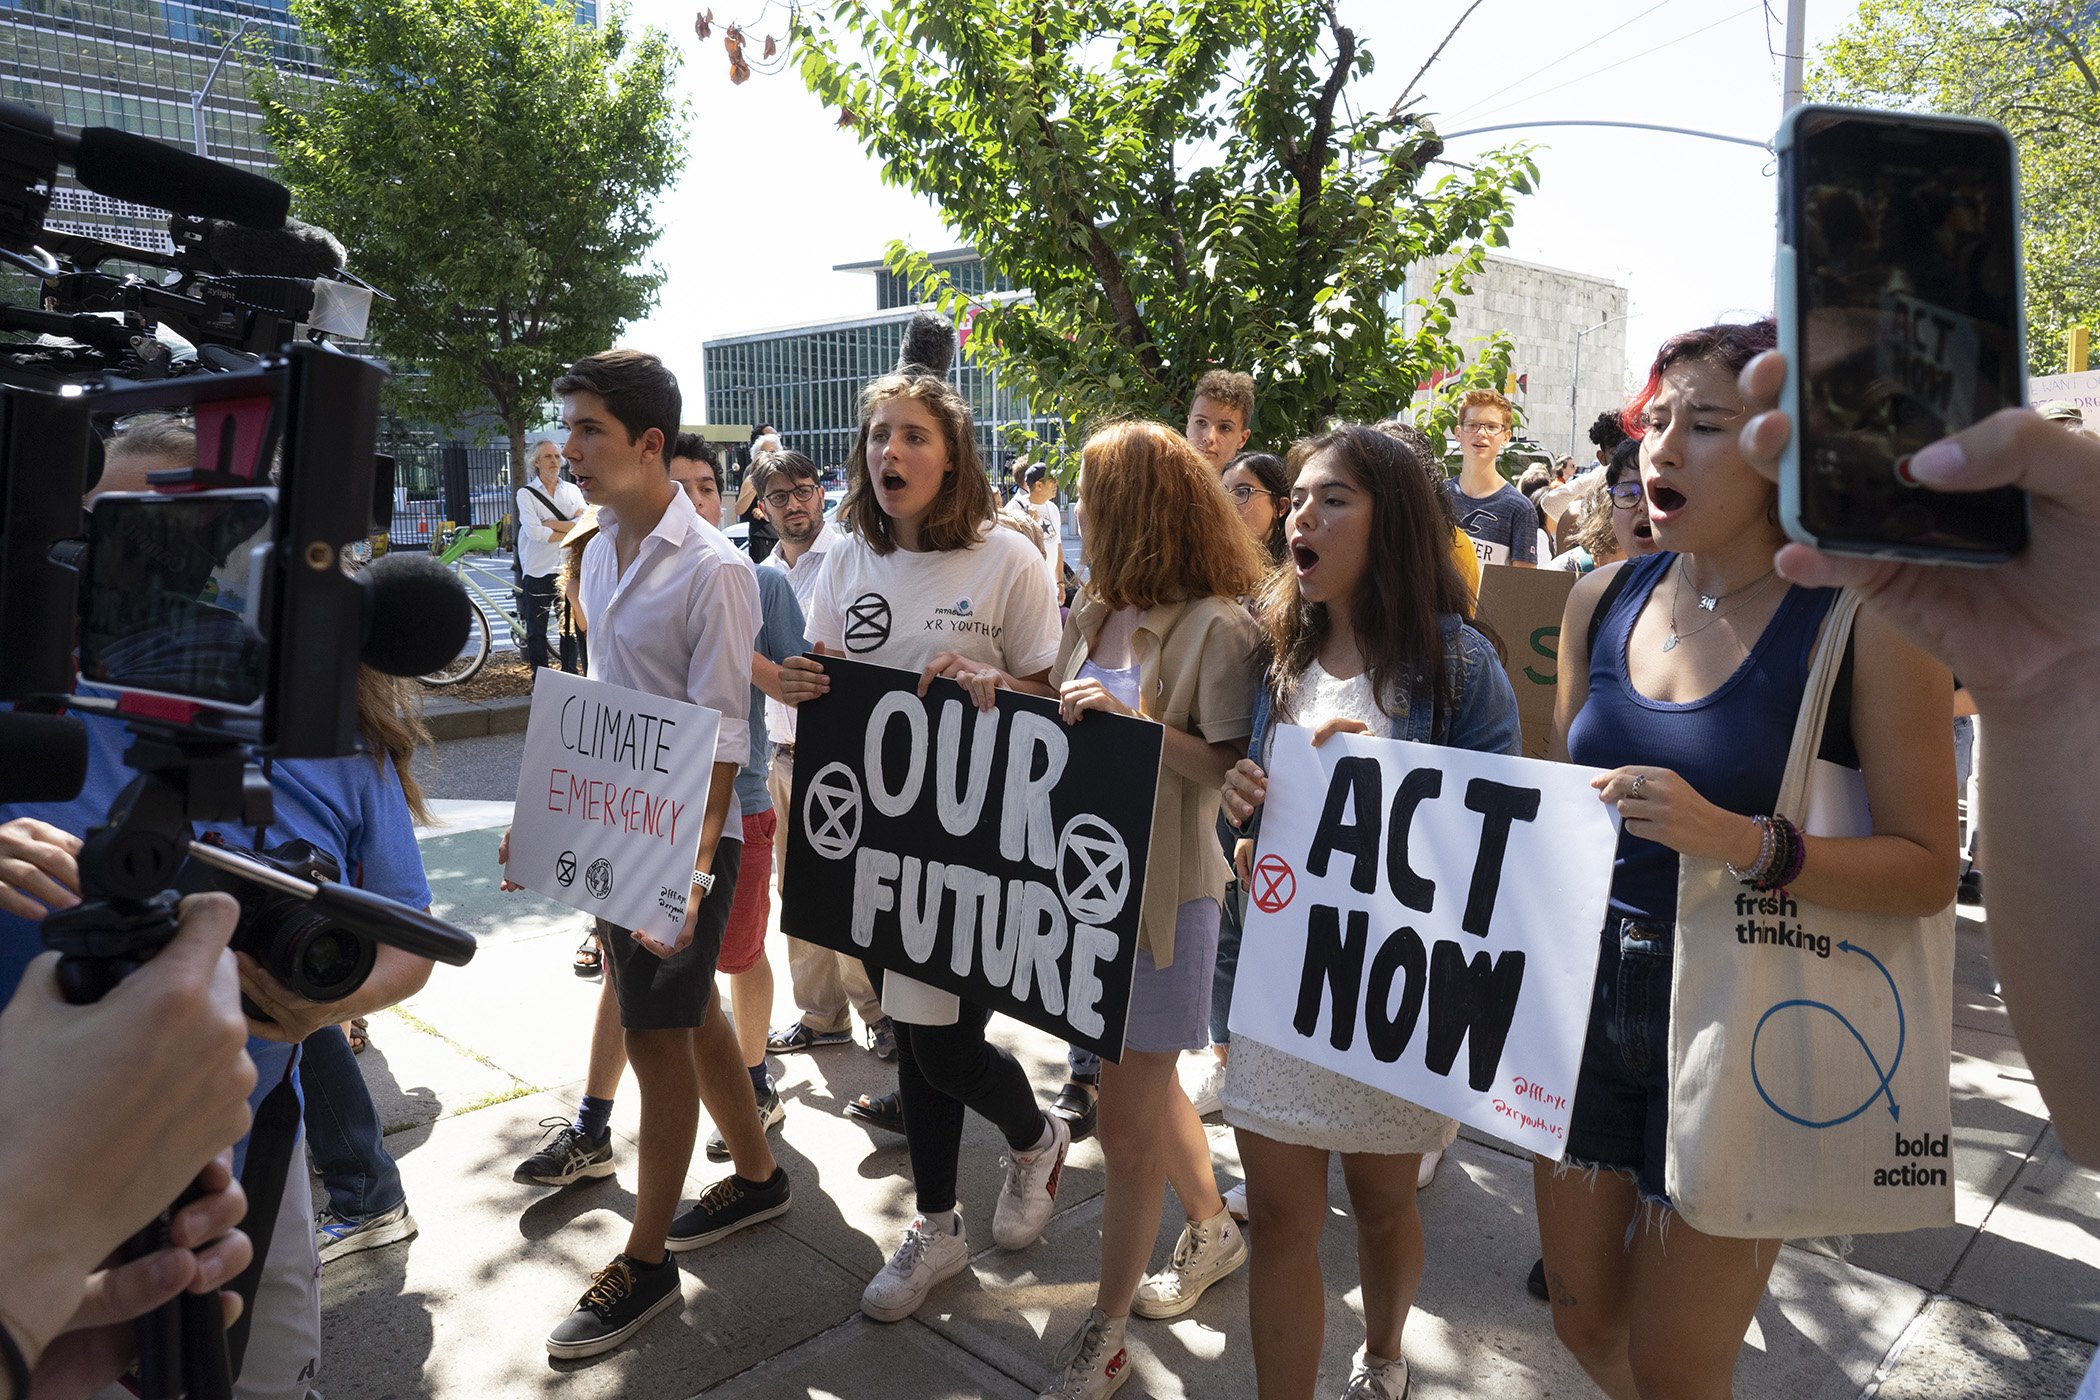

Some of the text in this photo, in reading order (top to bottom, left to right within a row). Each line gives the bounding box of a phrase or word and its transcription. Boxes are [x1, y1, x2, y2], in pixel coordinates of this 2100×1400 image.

[207, 287, 236, 300] zylight
[923, 618, 944, 631] XR
[950, 620, 990, 636] YOUTH
[560, 694, 676, 774] CLIMATE
[863, 690, 1070, 870] OUR
[547, 768, 685, 847] EMERGENCY
[1306, 756, 1541, 938] ACT
[1734, 892, 1798, 918] fresh
[850, 845, 1120, 1040] FUTURE
[1735, 919, 1831, 959] thnking
[1292, 904, 1526, 1092] NOW
[1512, 1076, 1566, 1110] @fff.nyc
[1895, 1132, 1949, 1158] bold
[1873, 1161, 1948, 1187] action
